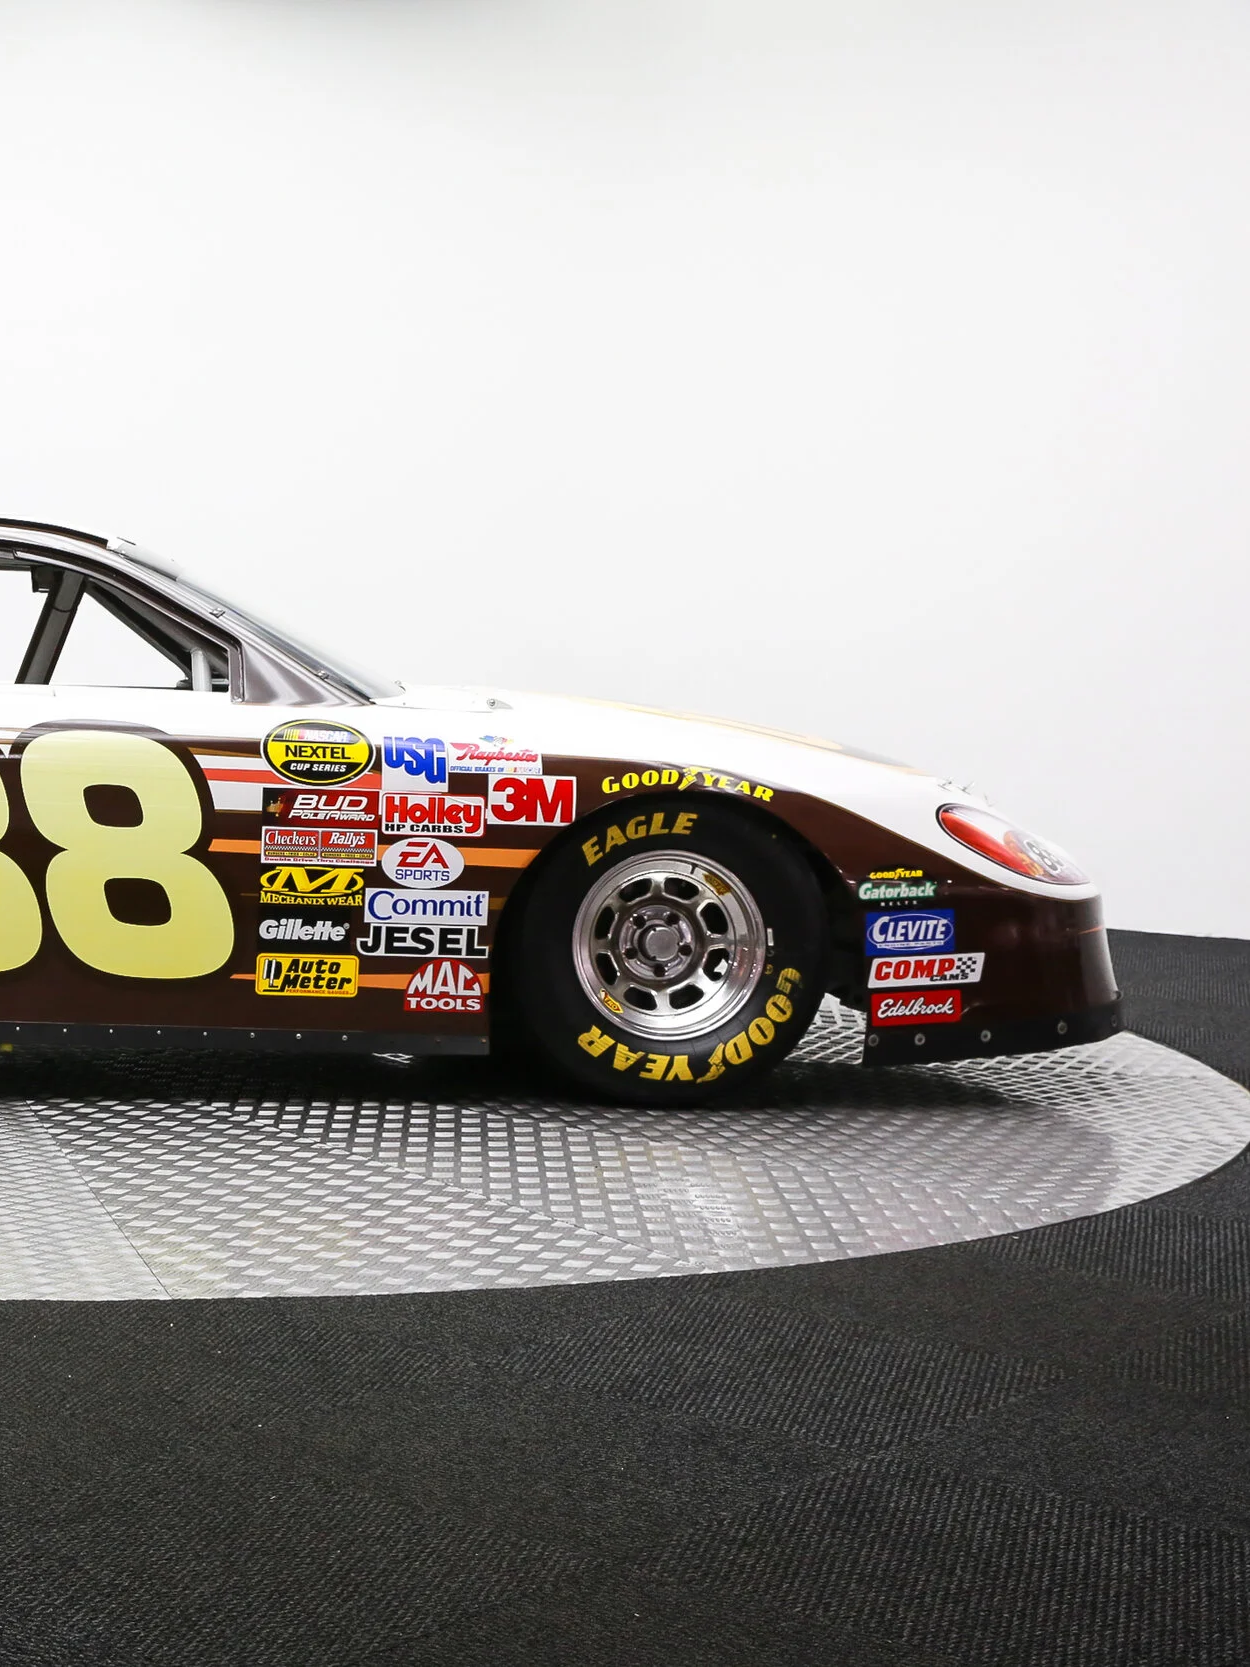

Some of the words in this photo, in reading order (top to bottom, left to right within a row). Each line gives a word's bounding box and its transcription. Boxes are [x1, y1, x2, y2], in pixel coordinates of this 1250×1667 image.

[302, 730, 349, 743] NASCAR
[285, 744, 351, 759] NEXTEL
[383, 736, 446, 784] USG
[290, 762, 310, 771] CUP
[312, 763, 347, 772] SERIES
[293, 794, 368, 810] BUD
[491, 777, 574, 824] 3M
[385, 795, 482, 834] Holley
[385, 823, 406, 832] HP
[409, 824, 464, 833] CARBS
[265, 830, 317, 846] Checkers
[329, 832, 366, 848] Rally's
[581, 812, 698, 867] EAGLE
[397, 841, 449, 869] EA
[395, 868, 450, 882] SPORTS
[260, 891, 332, 906] MECHANIX
[332, 894, 363, 907] WEAR
[859, 880, 937, 900] Gatorback
[368, 890, 483, 921] Commit
[259, 918, 346, 941] Gillette
[872, 916, 948, 942] CLEVITE
[359, 925, 488, 957] JESEL
[285, 958, 342, 974] Auto
[874, 957, 956, 982] COMP
[280, 973, 353, 990] Meter
[407, 961, 482, 996] MAC
[929, 971, 970, 982] CAMS
[406, 997, 482, 1011] TOOLS
[877, 996, 954, 1019] Edelbrock
